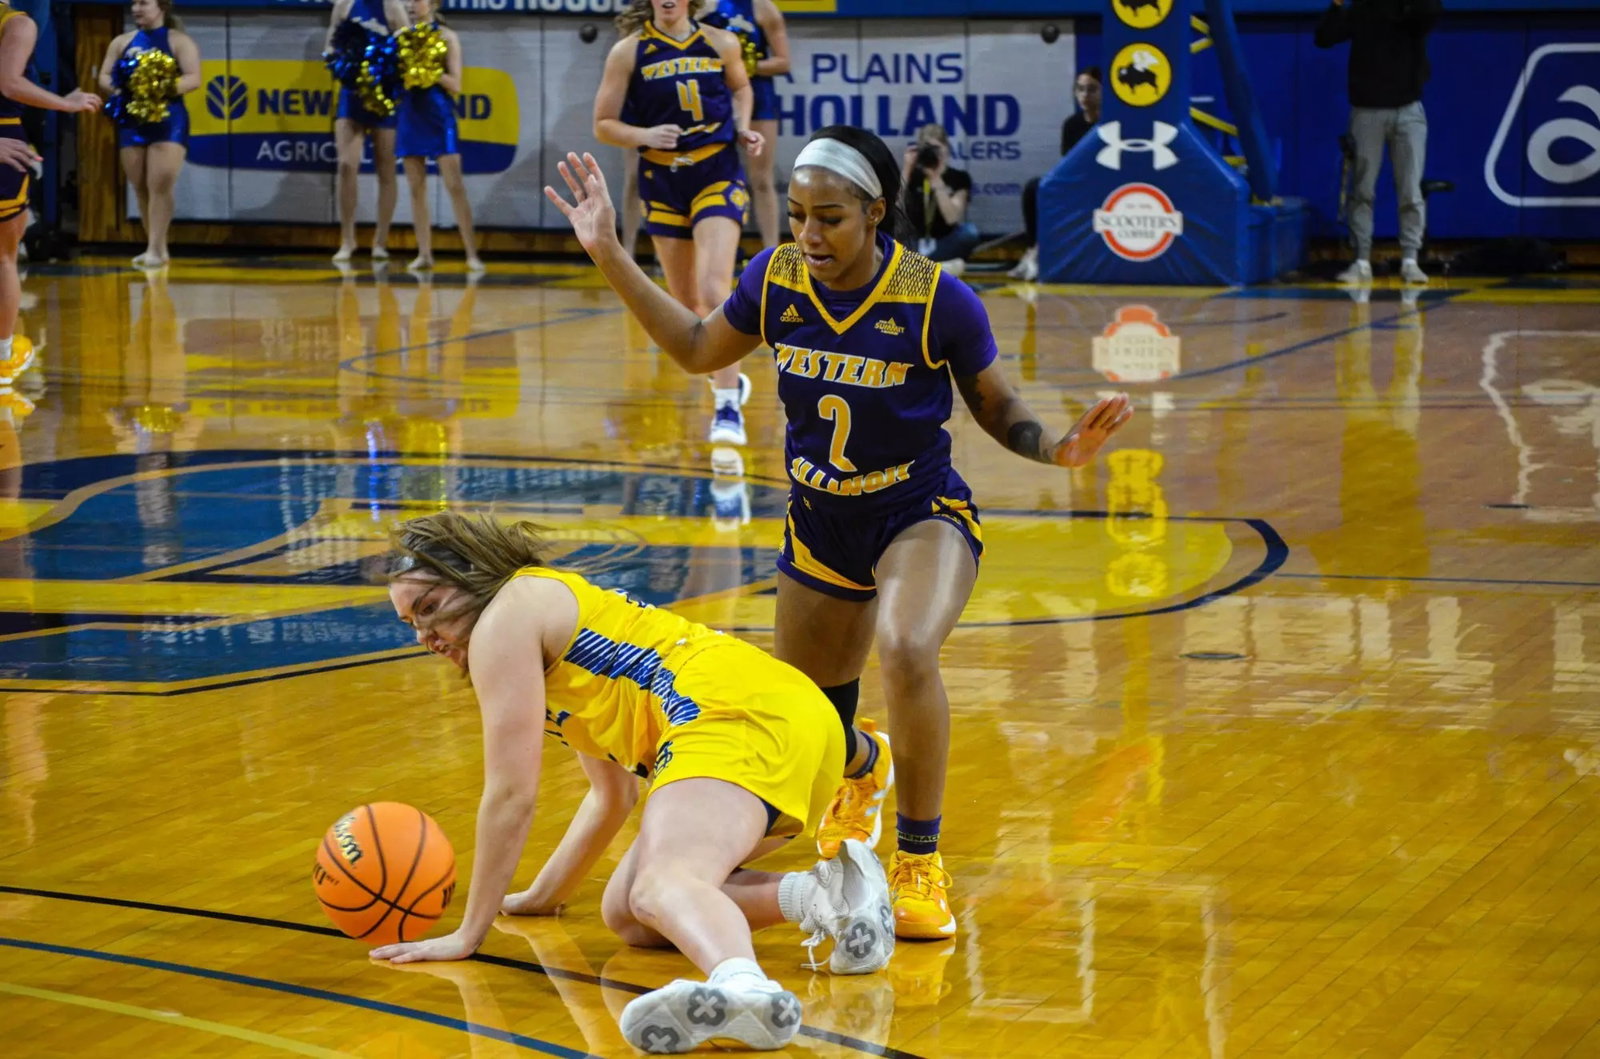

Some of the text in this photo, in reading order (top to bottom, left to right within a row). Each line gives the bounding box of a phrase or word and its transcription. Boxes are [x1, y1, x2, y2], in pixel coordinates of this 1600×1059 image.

[812, 53, 963, 83] PLAINS
[258, 90, 331, 115] NEW
[676, 79, 703, 121] 4
[776, 94, 1021, 136] HOLLAND
[775, 343, 914, 388] WESTERN
[818, 394, 857, 472] 2
